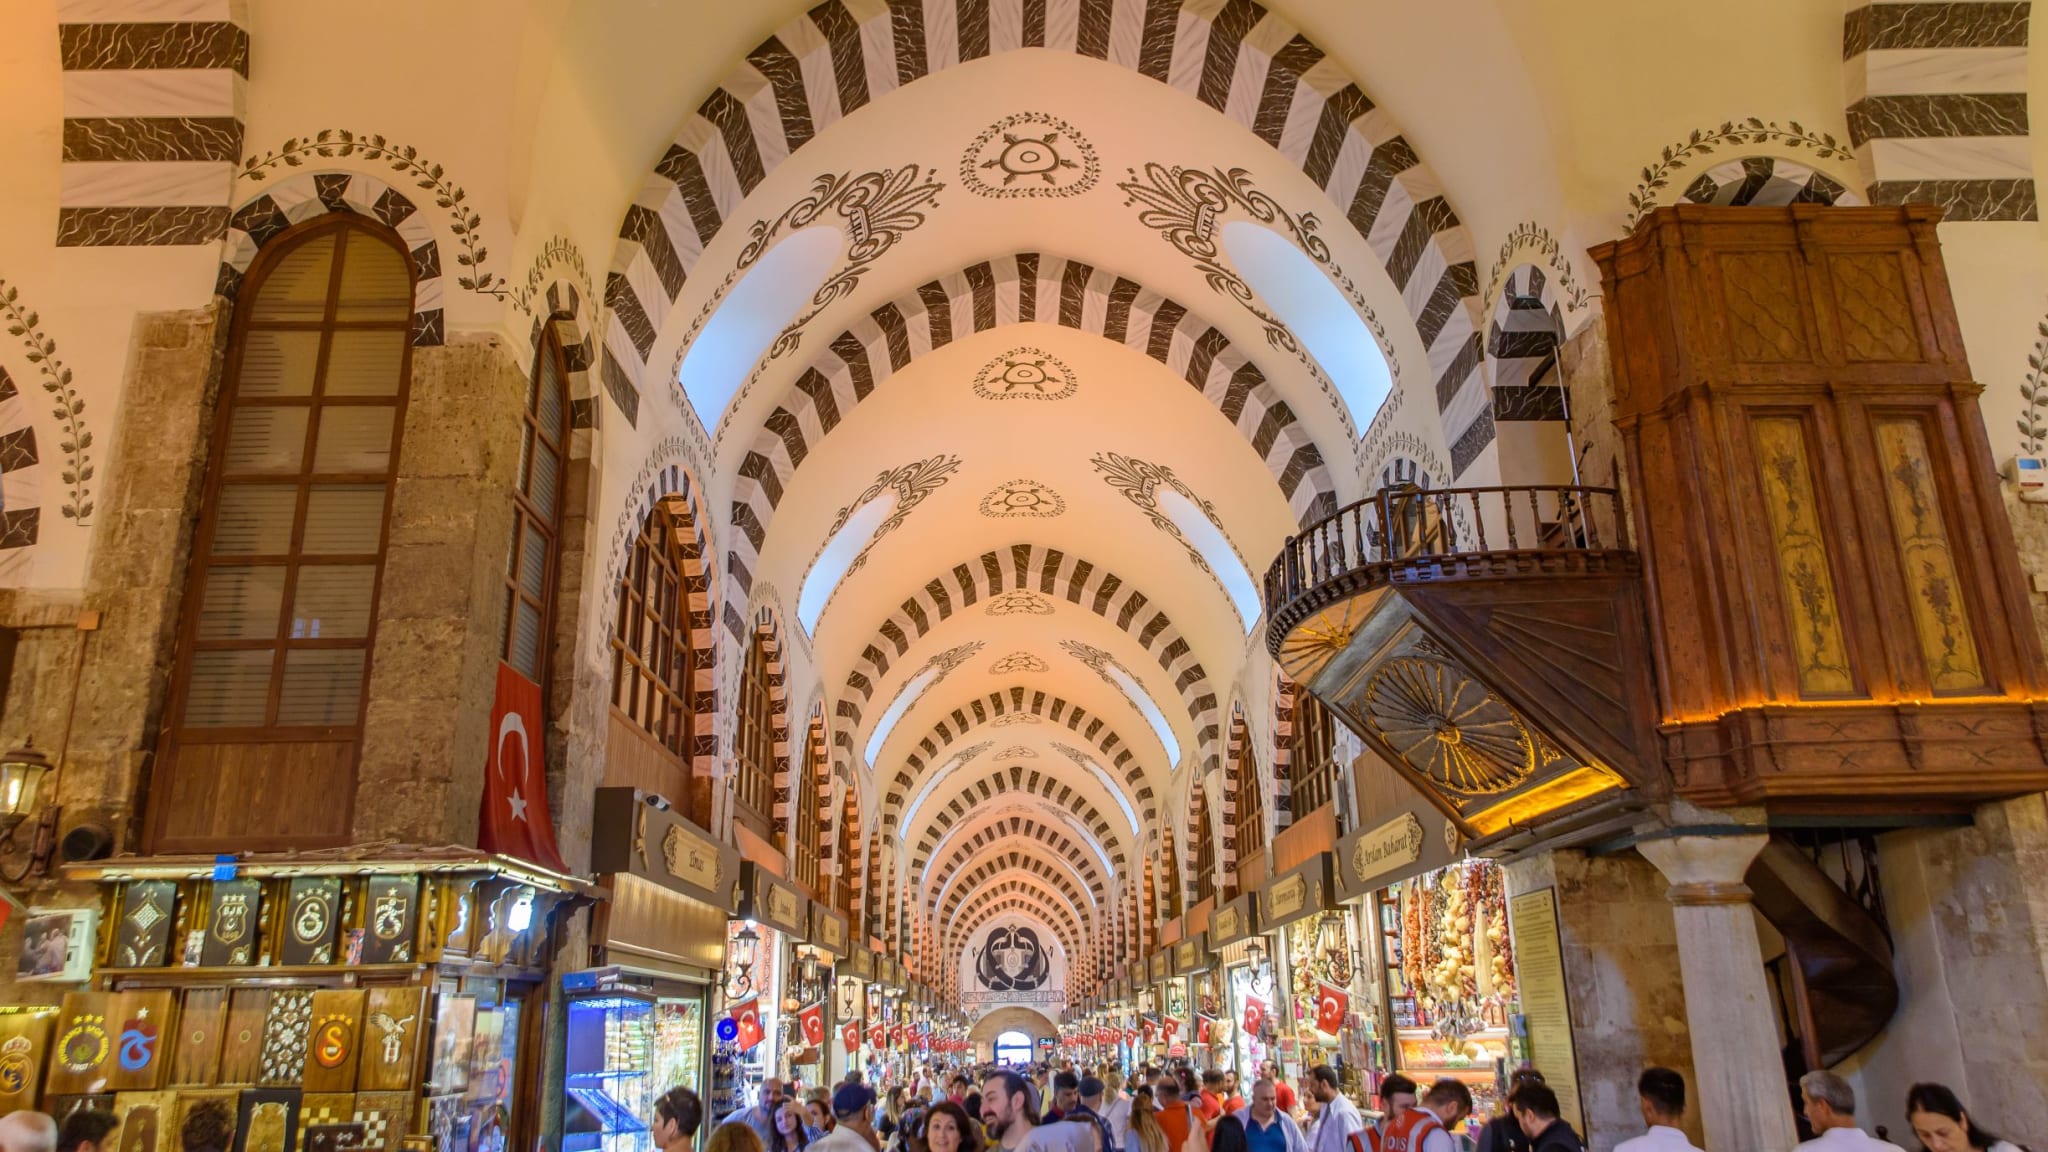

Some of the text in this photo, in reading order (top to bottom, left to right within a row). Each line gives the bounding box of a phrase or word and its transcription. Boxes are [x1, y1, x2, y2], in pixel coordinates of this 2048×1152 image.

[1446, 826, 1455, 845] 39
[1364, 833, 1408, 866] Arslan Baharat
[222, 906, 244, 917] BJK
